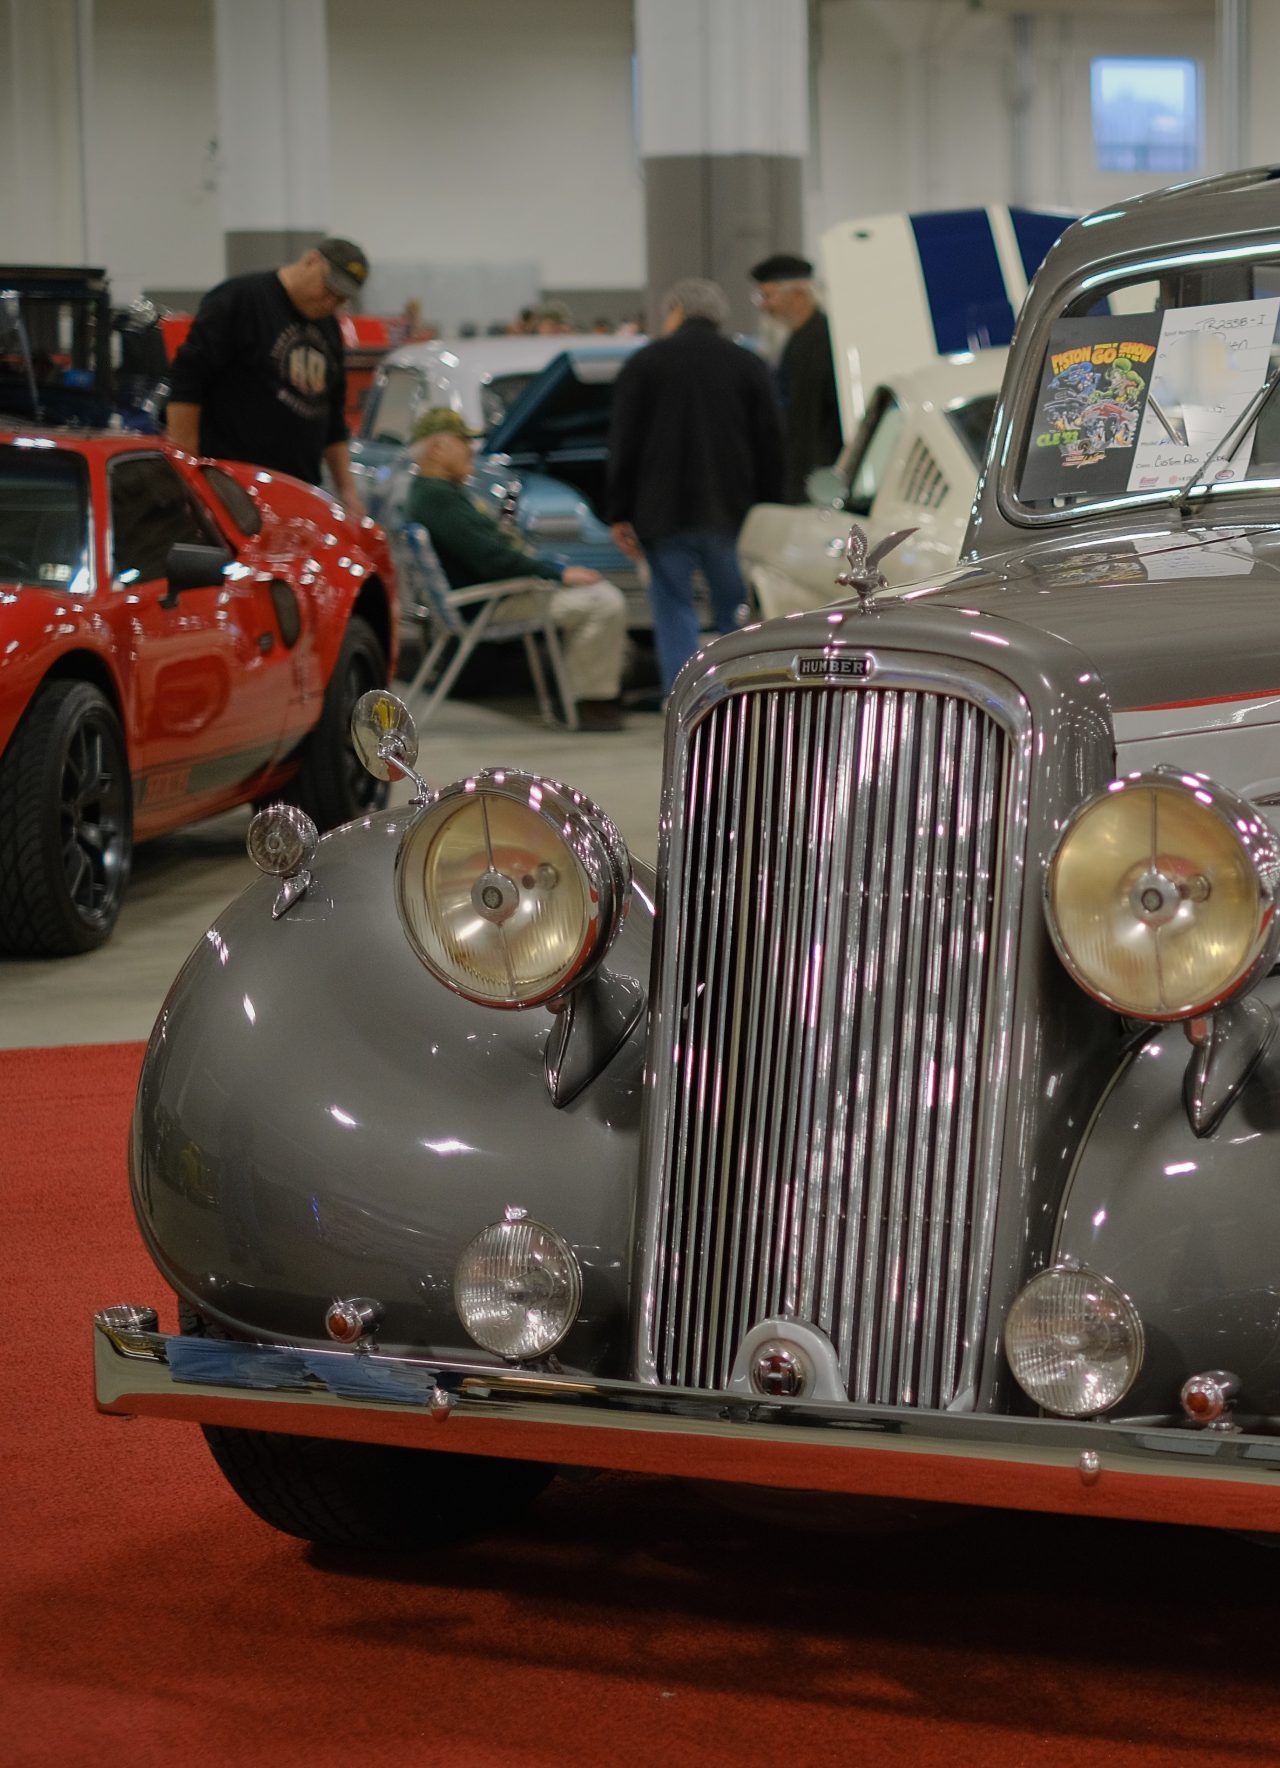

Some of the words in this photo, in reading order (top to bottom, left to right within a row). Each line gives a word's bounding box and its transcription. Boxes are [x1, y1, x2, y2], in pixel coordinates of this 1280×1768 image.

[1051, 346, 1092, 375] PISTON
[1091, 348, 1118, 365] GO
[1119, 341, 1156, 364] SHOW
[802, 660, 864, 673] HUMBER
